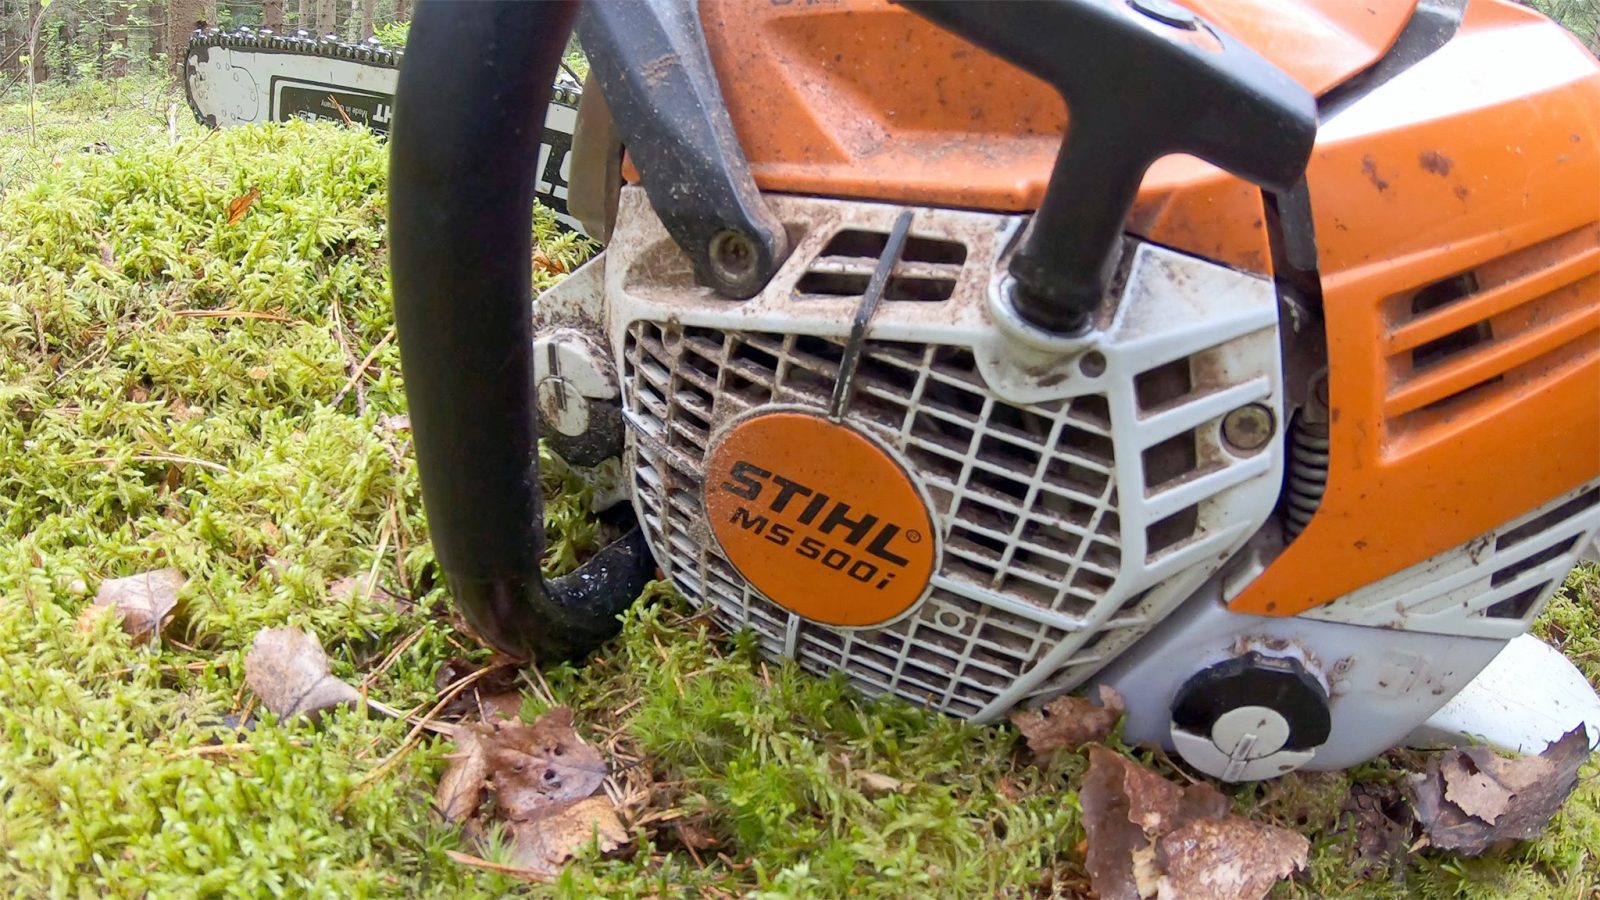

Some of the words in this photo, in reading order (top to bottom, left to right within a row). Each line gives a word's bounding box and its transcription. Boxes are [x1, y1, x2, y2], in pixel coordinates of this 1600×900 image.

[352, 107, 368, 118] Made
[729, 507, 795, 546] MS
[795, 536, 897, 590] 500i
